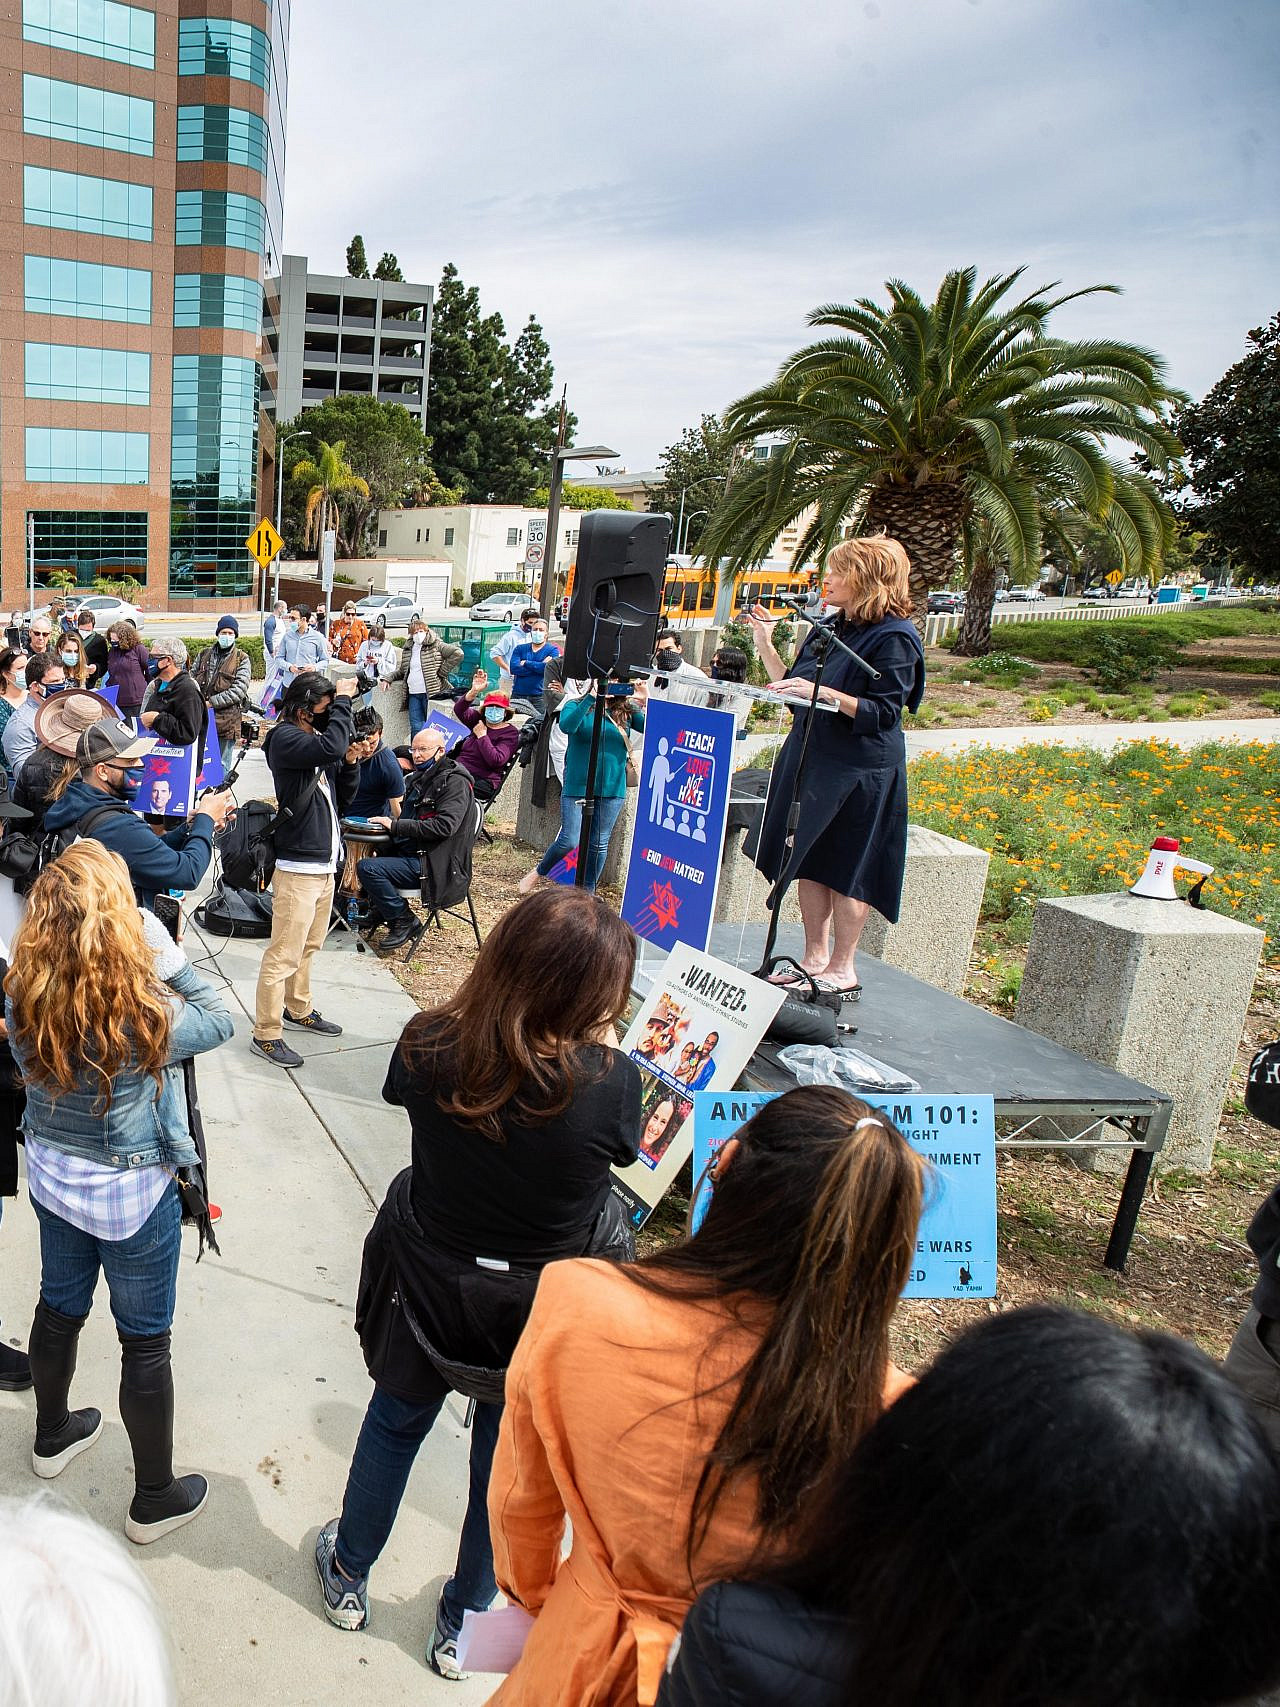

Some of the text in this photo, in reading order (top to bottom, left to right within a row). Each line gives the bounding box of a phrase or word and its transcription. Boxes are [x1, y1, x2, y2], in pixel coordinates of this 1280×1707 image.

[529, 532, 543, 541] 30
[677, 729, 715, 754] #TEACH
[686, 756, 712, 779] LOVE
[1154, 861, 1164, 875] PYLE
[924, 1105, 979, 1125] 101:
[611, 1184, 636, 1209] please notify
[930, 1241, 972, 1253] WARS
